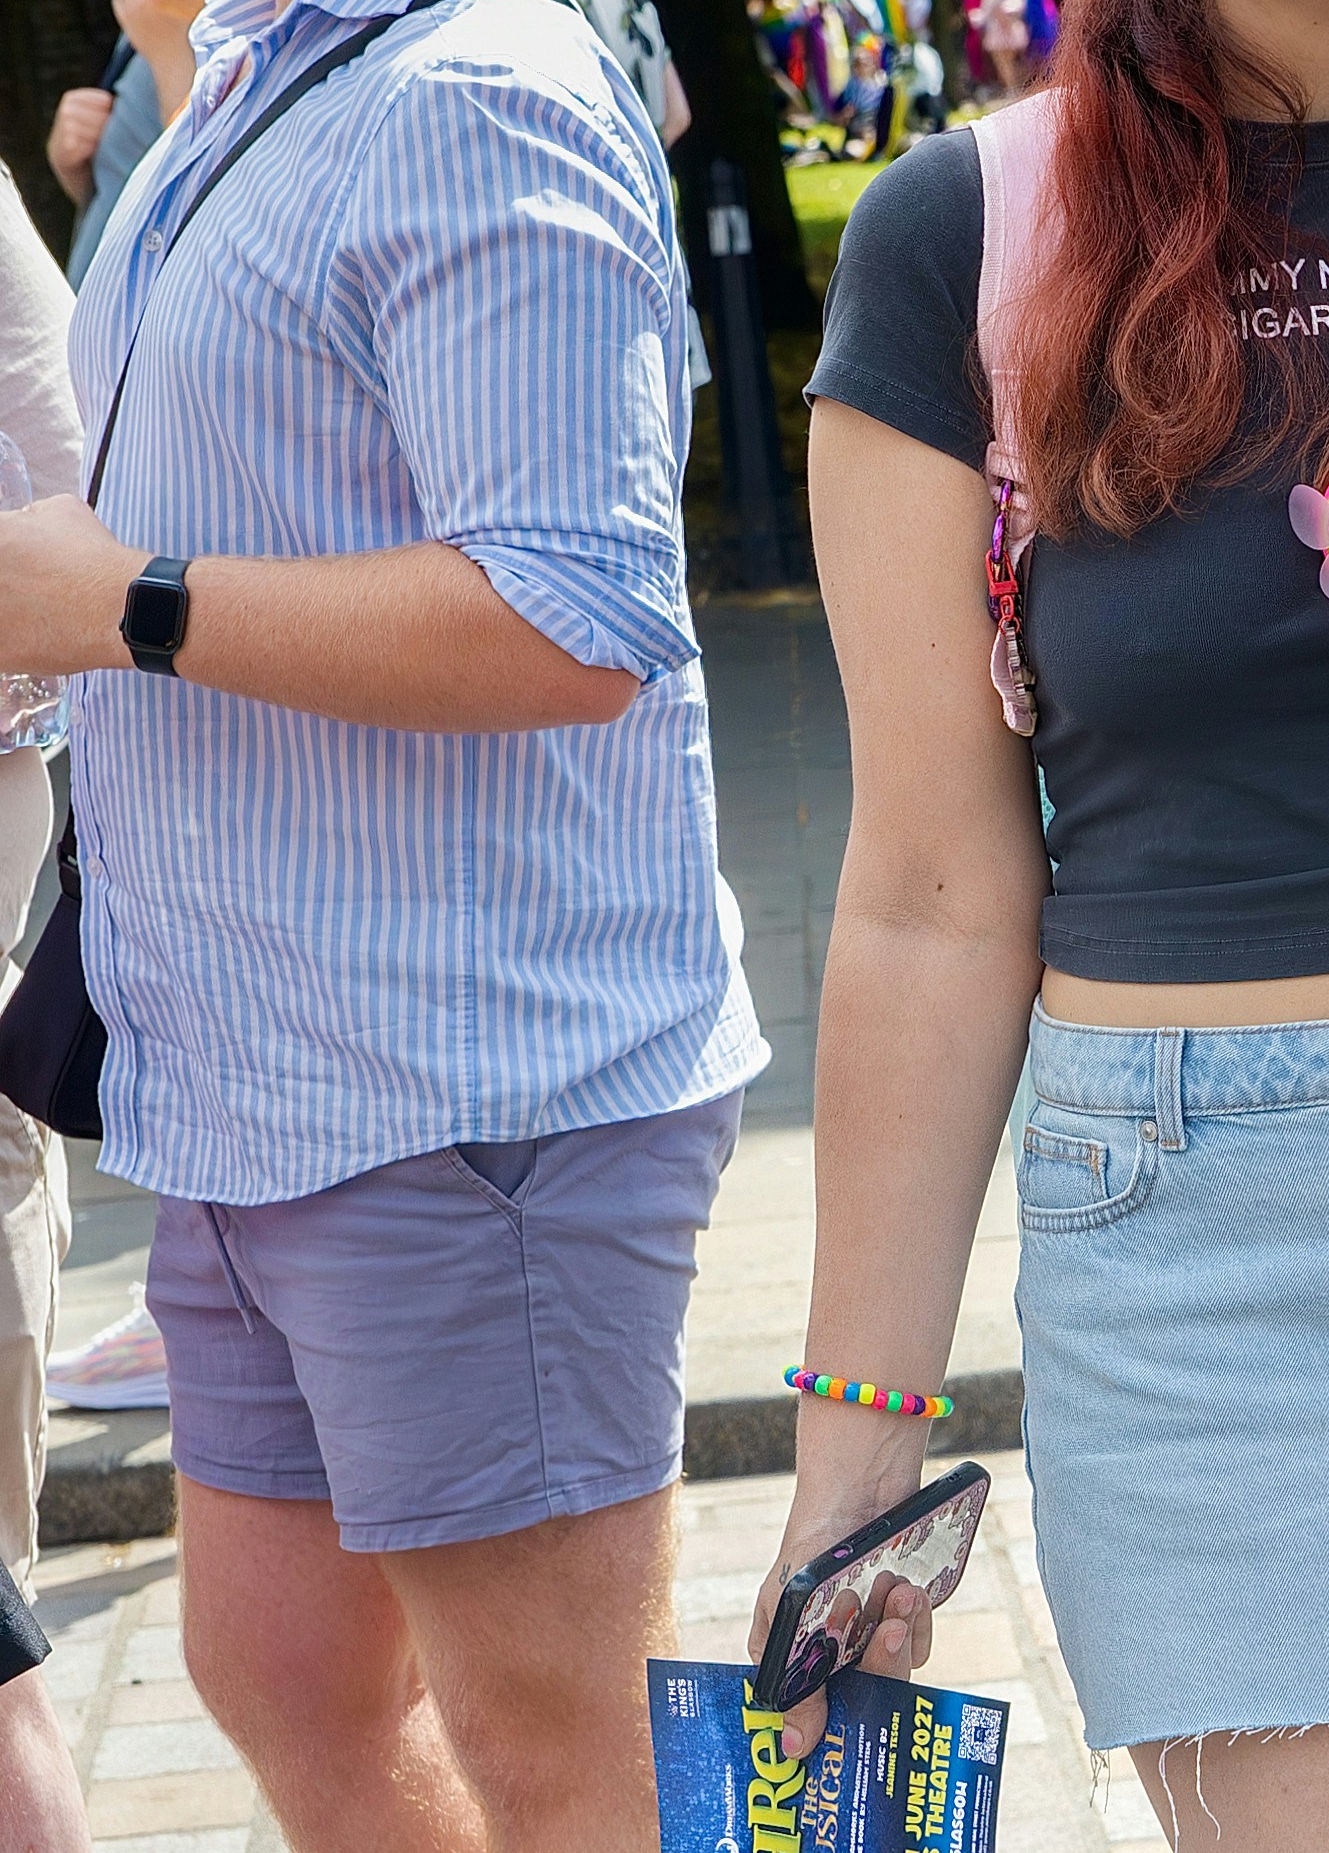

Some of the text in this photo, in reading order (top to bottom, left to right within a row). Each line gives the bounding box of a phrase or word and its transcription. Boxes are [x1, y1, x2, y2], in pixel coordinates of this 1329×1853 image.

[667, 1678, 677, 1704] THE
[676, 1678, 688, 1717] KING'S
[911, 1695, 933, 1763] 2027
[876, 1727, 888, 1782] MUSIC BY
[886, 1752, 896, 1798] JEANINE
[905, 1770, 927, 1841] JUNE
[925, 1724, 953, 1837] THEATRE
[860, 1804, 866, 1816] BY
